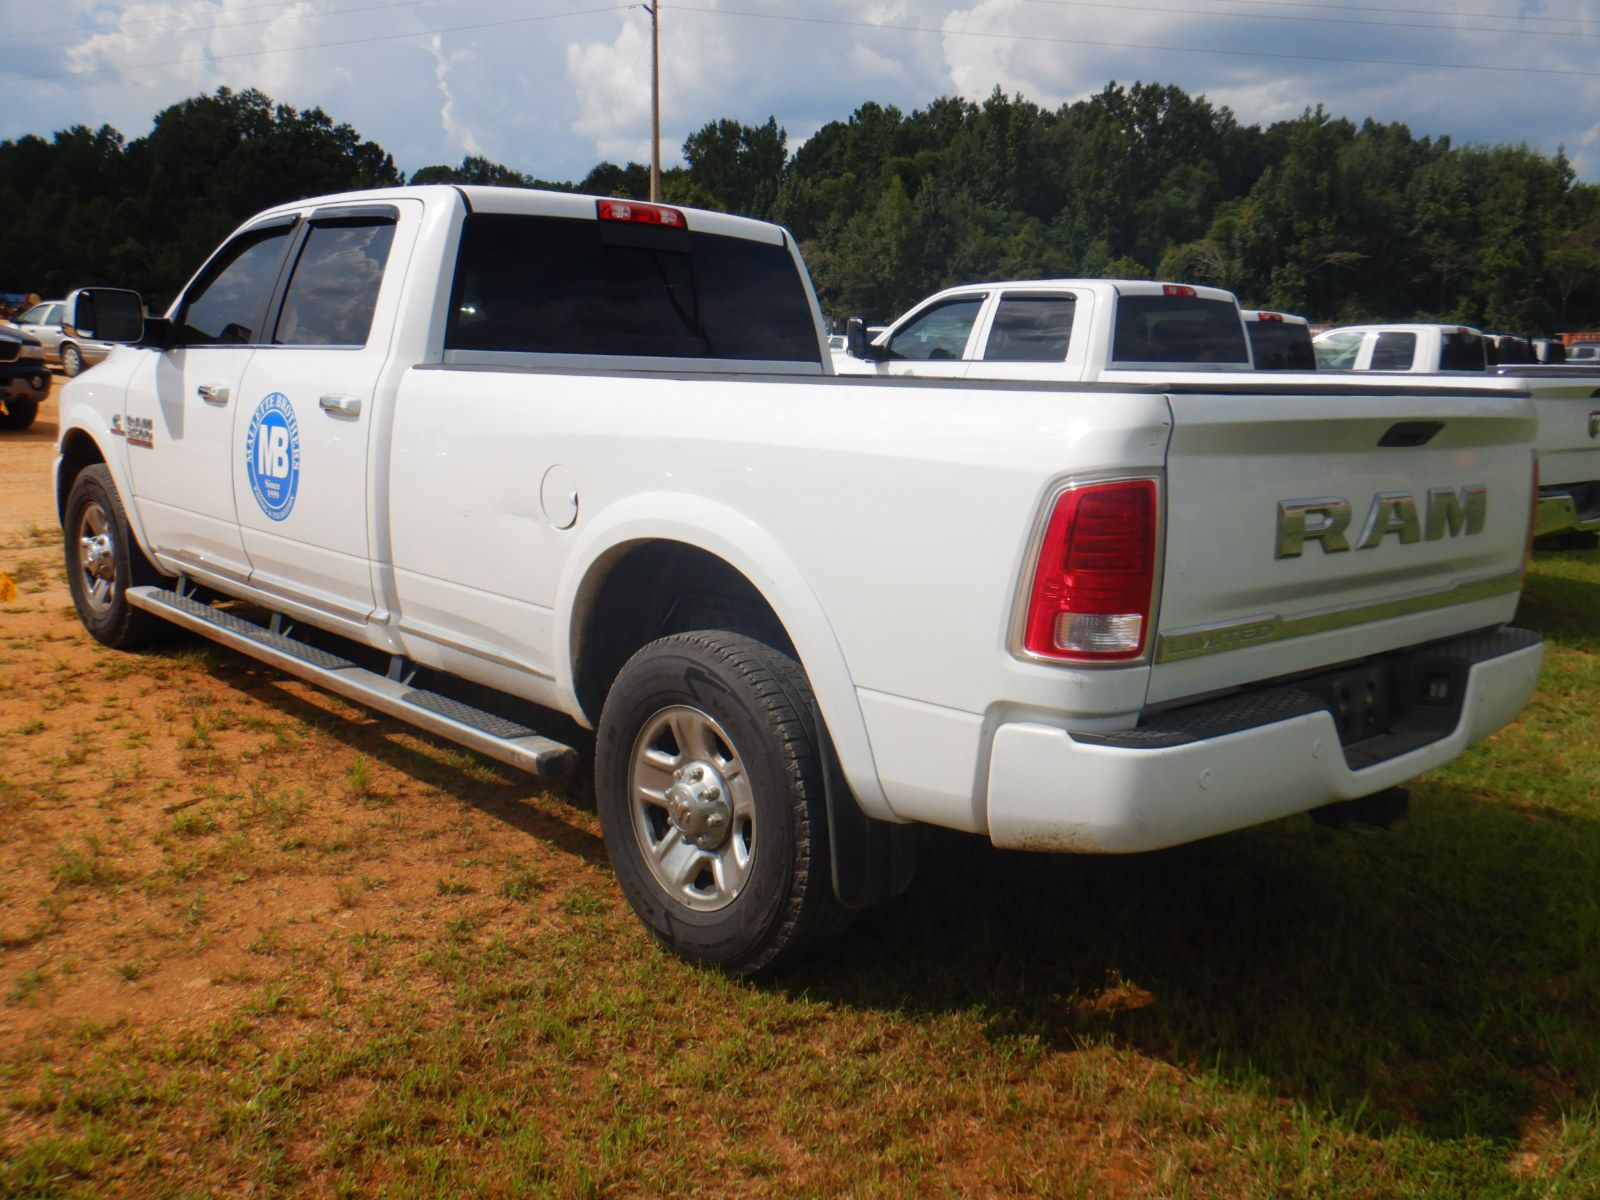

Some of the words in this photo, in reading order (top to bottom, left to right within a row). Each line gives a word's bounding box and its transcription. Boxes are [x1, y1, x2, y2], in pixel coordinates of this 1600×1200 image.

[258, 424, 289, 478] MB
[277, 395, 300, 470] BROTHERS
[1275, 484, 1488, 560] RAM
[1169, 626, 1275, 656] LIMITED
